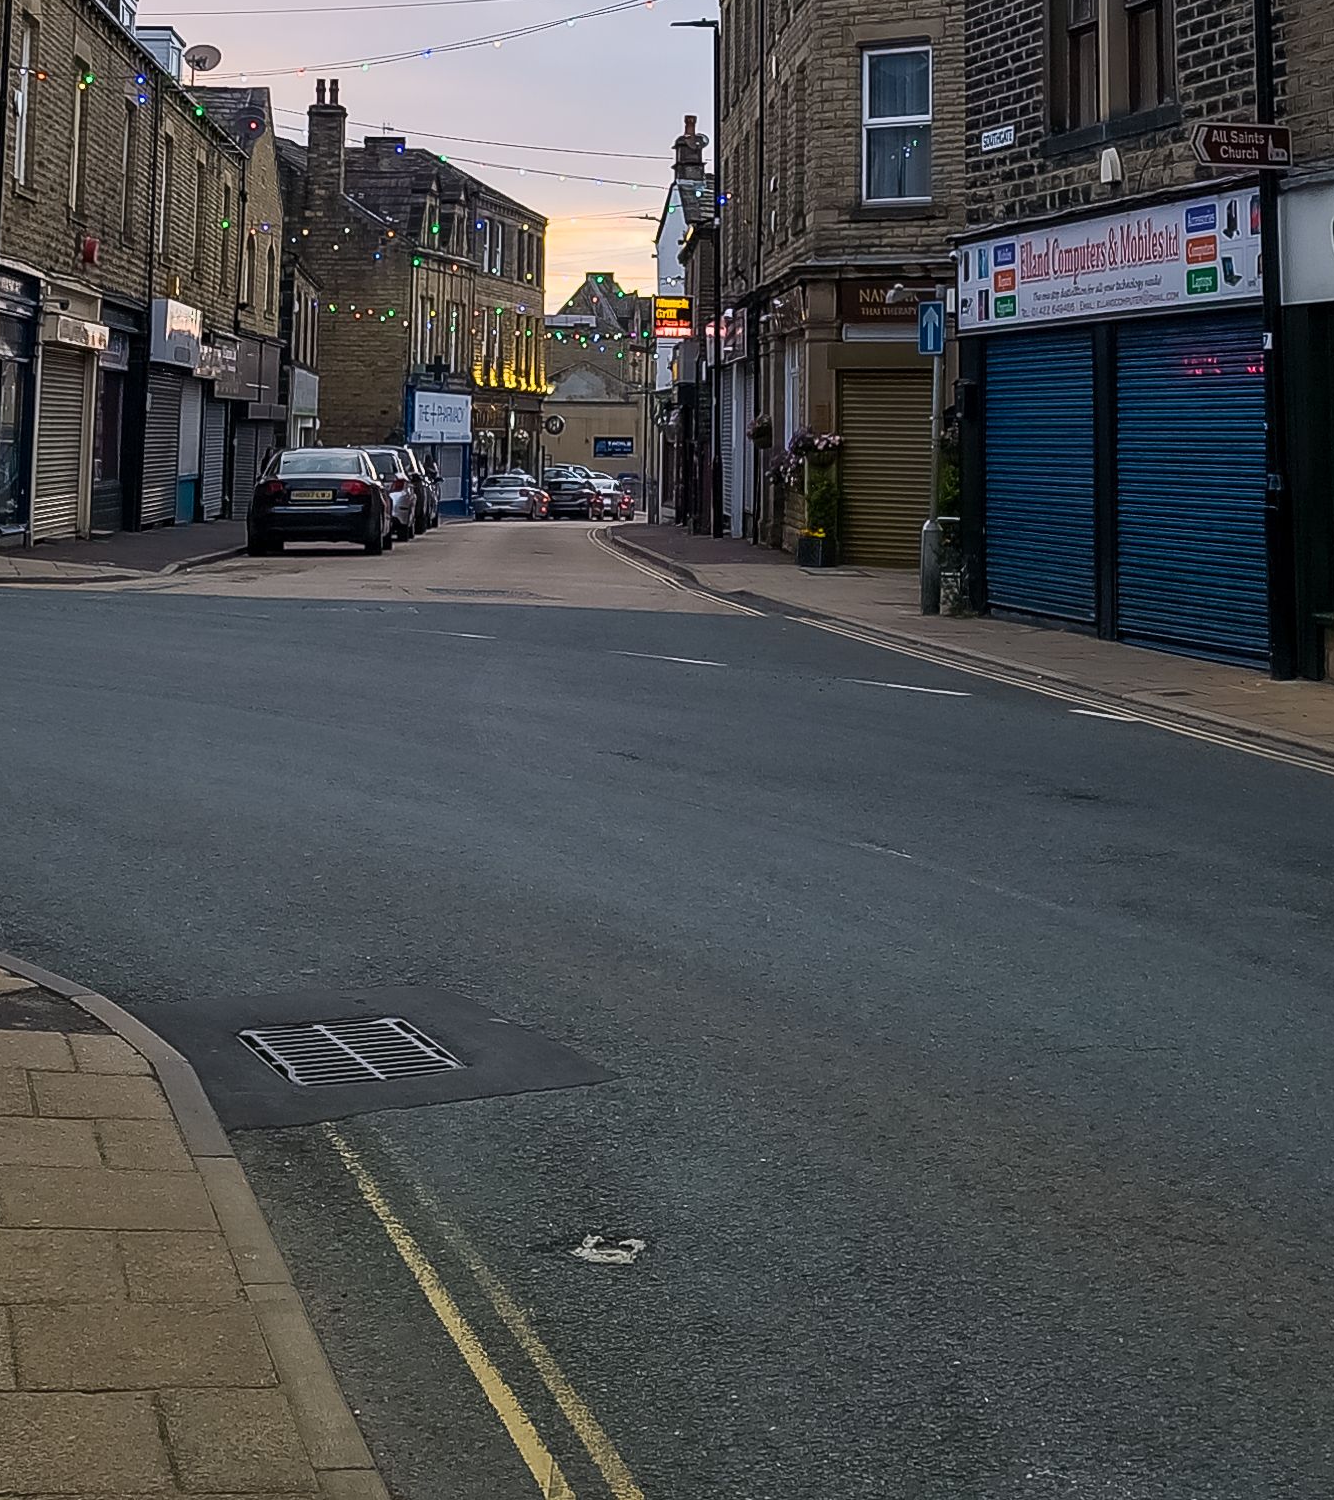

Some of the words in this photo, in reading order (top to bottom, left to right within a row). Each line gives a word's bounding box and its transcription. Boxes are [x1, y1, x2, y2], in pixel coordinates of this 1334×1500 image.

[1211, 129, 1228, 143] All
[1230, 131, 1265, 145] Saints
[1220, 145, 1259, 160] Church
[1020, 238, 1050, 282] Elland
[1052, 238, 1107, 284] Computers
[1108, 227, 1117, 266] &
[1119, 217, 1165, 262] Mobiles
[861, 307, 880, 316] THAI
[883, 307, 917, 316] THERAPY
